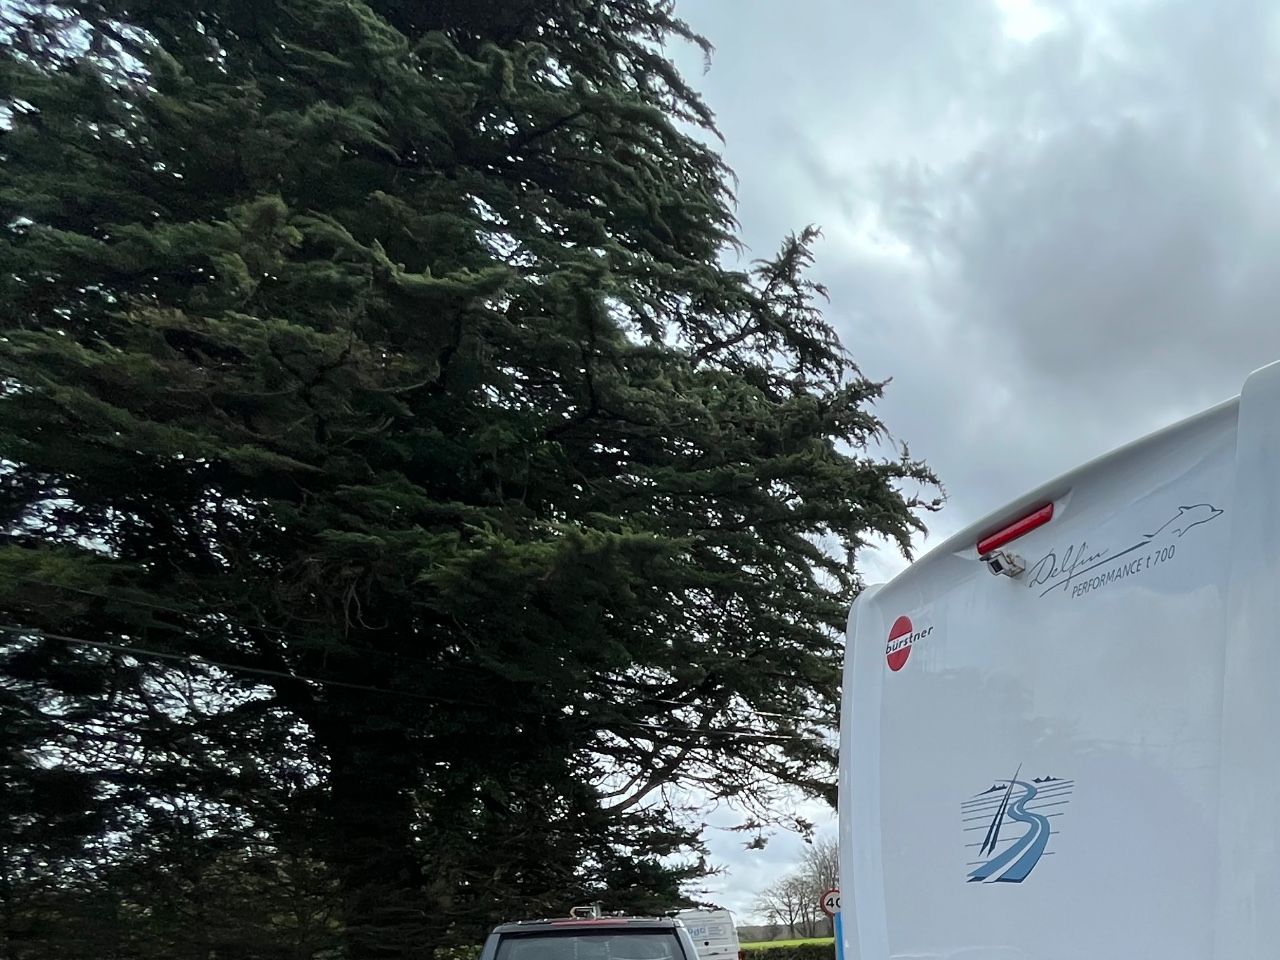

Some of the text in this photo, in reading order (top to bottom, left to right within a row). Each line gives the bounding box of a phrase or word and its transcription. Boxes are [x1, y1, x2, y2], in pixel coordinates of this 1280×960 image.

[1072, 557, 1143, 599] PERFORMANCE
[1153, 545, 1176, 566] 700
[885, 626, 934, 655] bürstner
